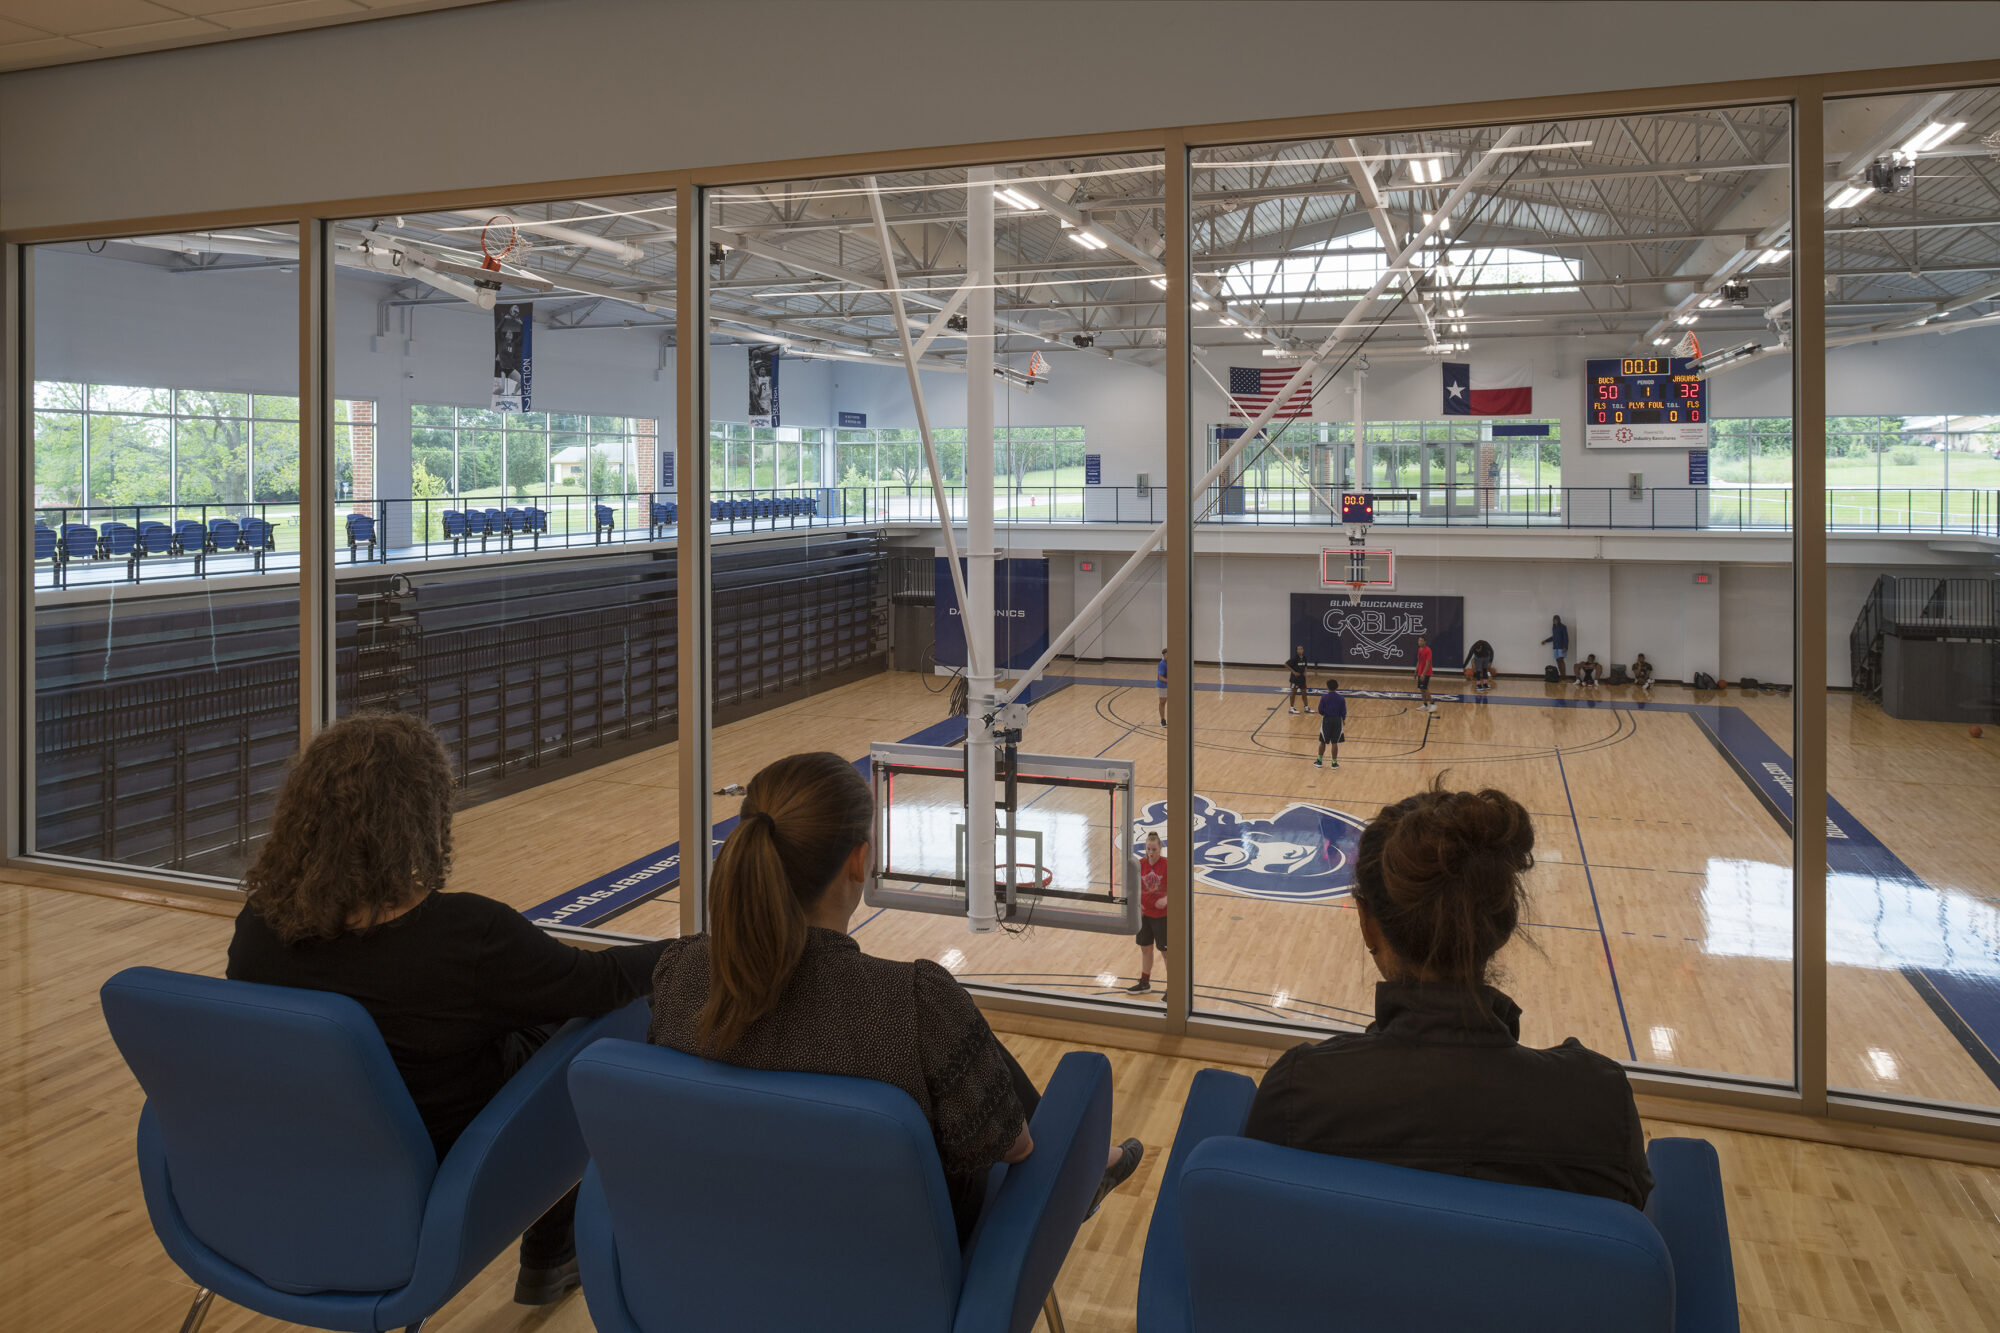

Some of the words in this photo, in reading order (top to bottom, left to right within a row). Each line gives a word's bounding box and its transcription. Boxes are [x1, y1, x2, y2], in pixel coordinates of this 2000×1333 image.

[1624, 359, 1658, 374] 00.0
[523, 358, 531, 396] SECTION
[1599, 385, 1618, 400] 50
[1646, 386, 1650, 397] 1
[1680, 383, 1699, 398] 32
[524, 398, 531, 411] 2
[1628, 401, 1645, 409] PLYR
[1648, 401, 1664, 409] FOUL
[1687, 400, 1699, 408] FLS
[1598, 411, 1606, 423] 0
[1615, 411, 1623, 423] 0
[1670, 410, 1678, 422] 0
[1691, 410, 1699, 422] 0
[1344, 496, 1365, 505] 00.0
[1360, 601, 1424, 609] BUCCANEERS
